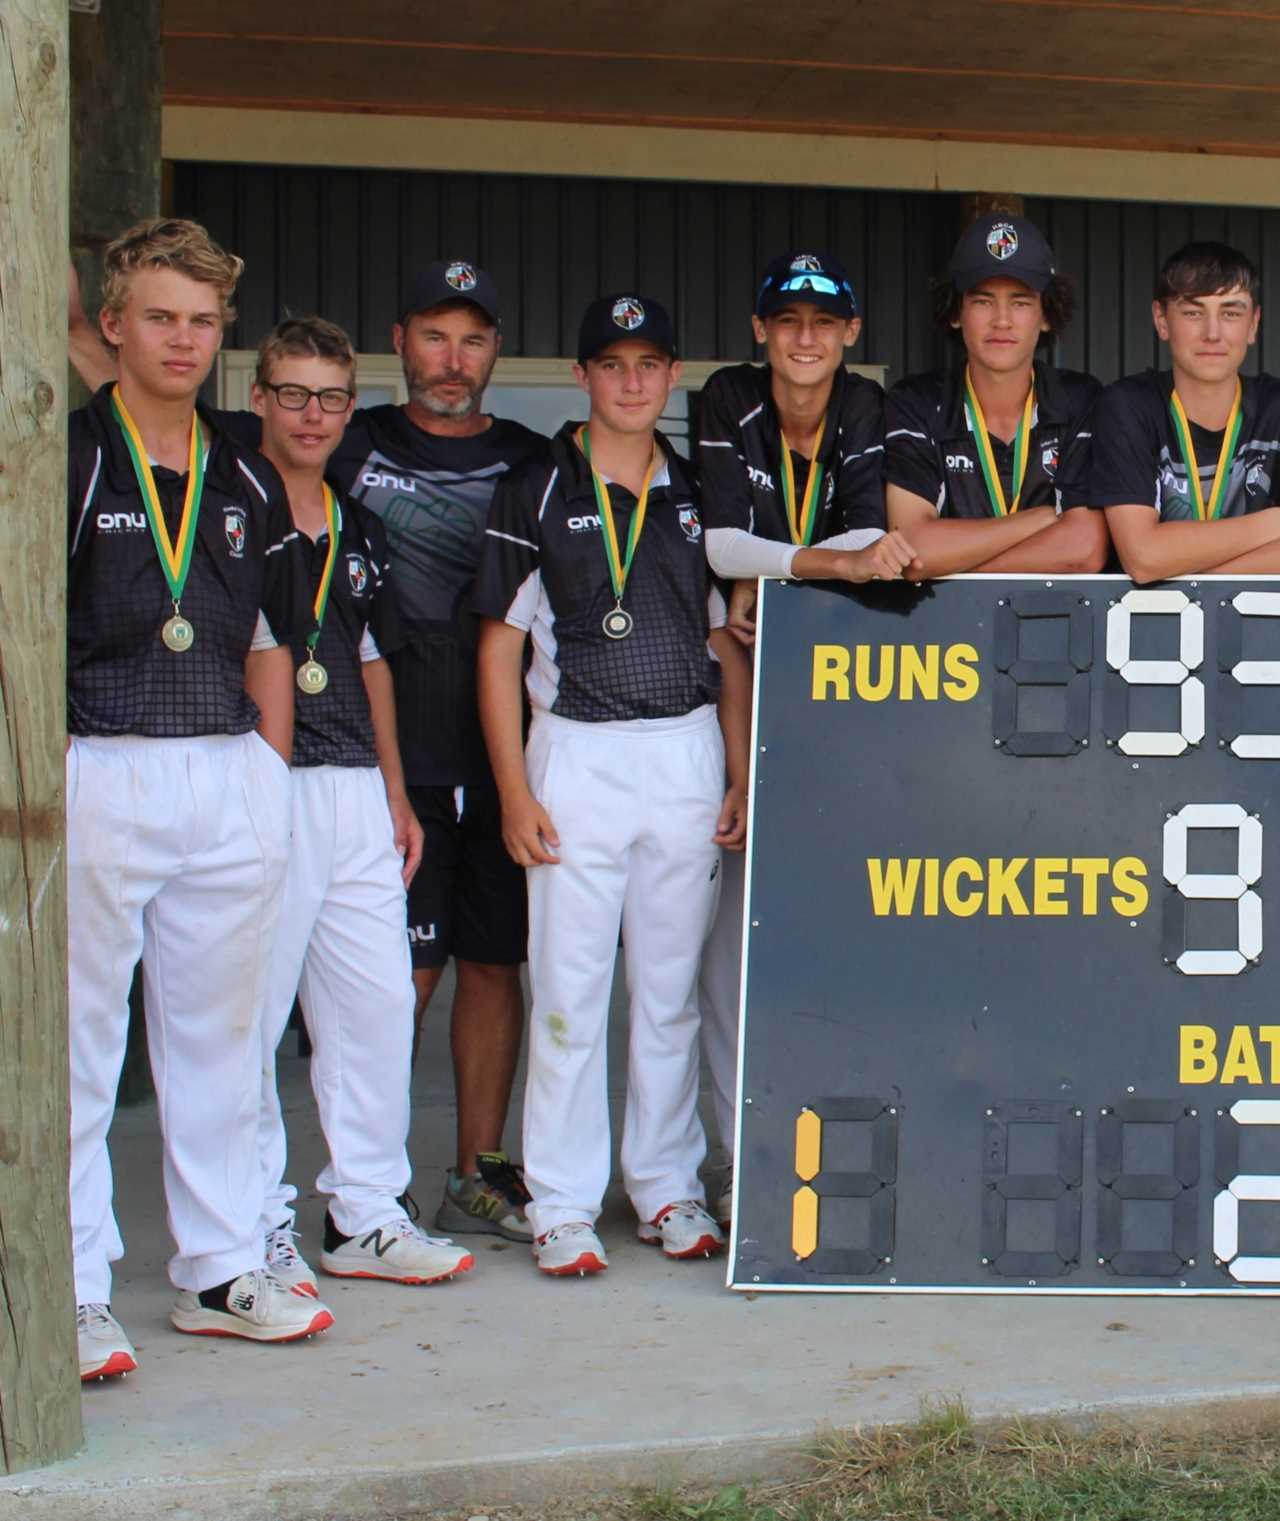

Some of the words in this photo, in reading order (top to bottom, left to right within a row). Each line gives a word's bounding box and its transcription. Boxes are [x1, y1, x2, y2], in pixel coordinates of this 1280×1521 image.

[97, 512, 147, 529] onu
[811, 643, 980, 702] RUNS
[866, 856, 1149, 918] WICKETS
[1162, 803, 1263, 975] 9
